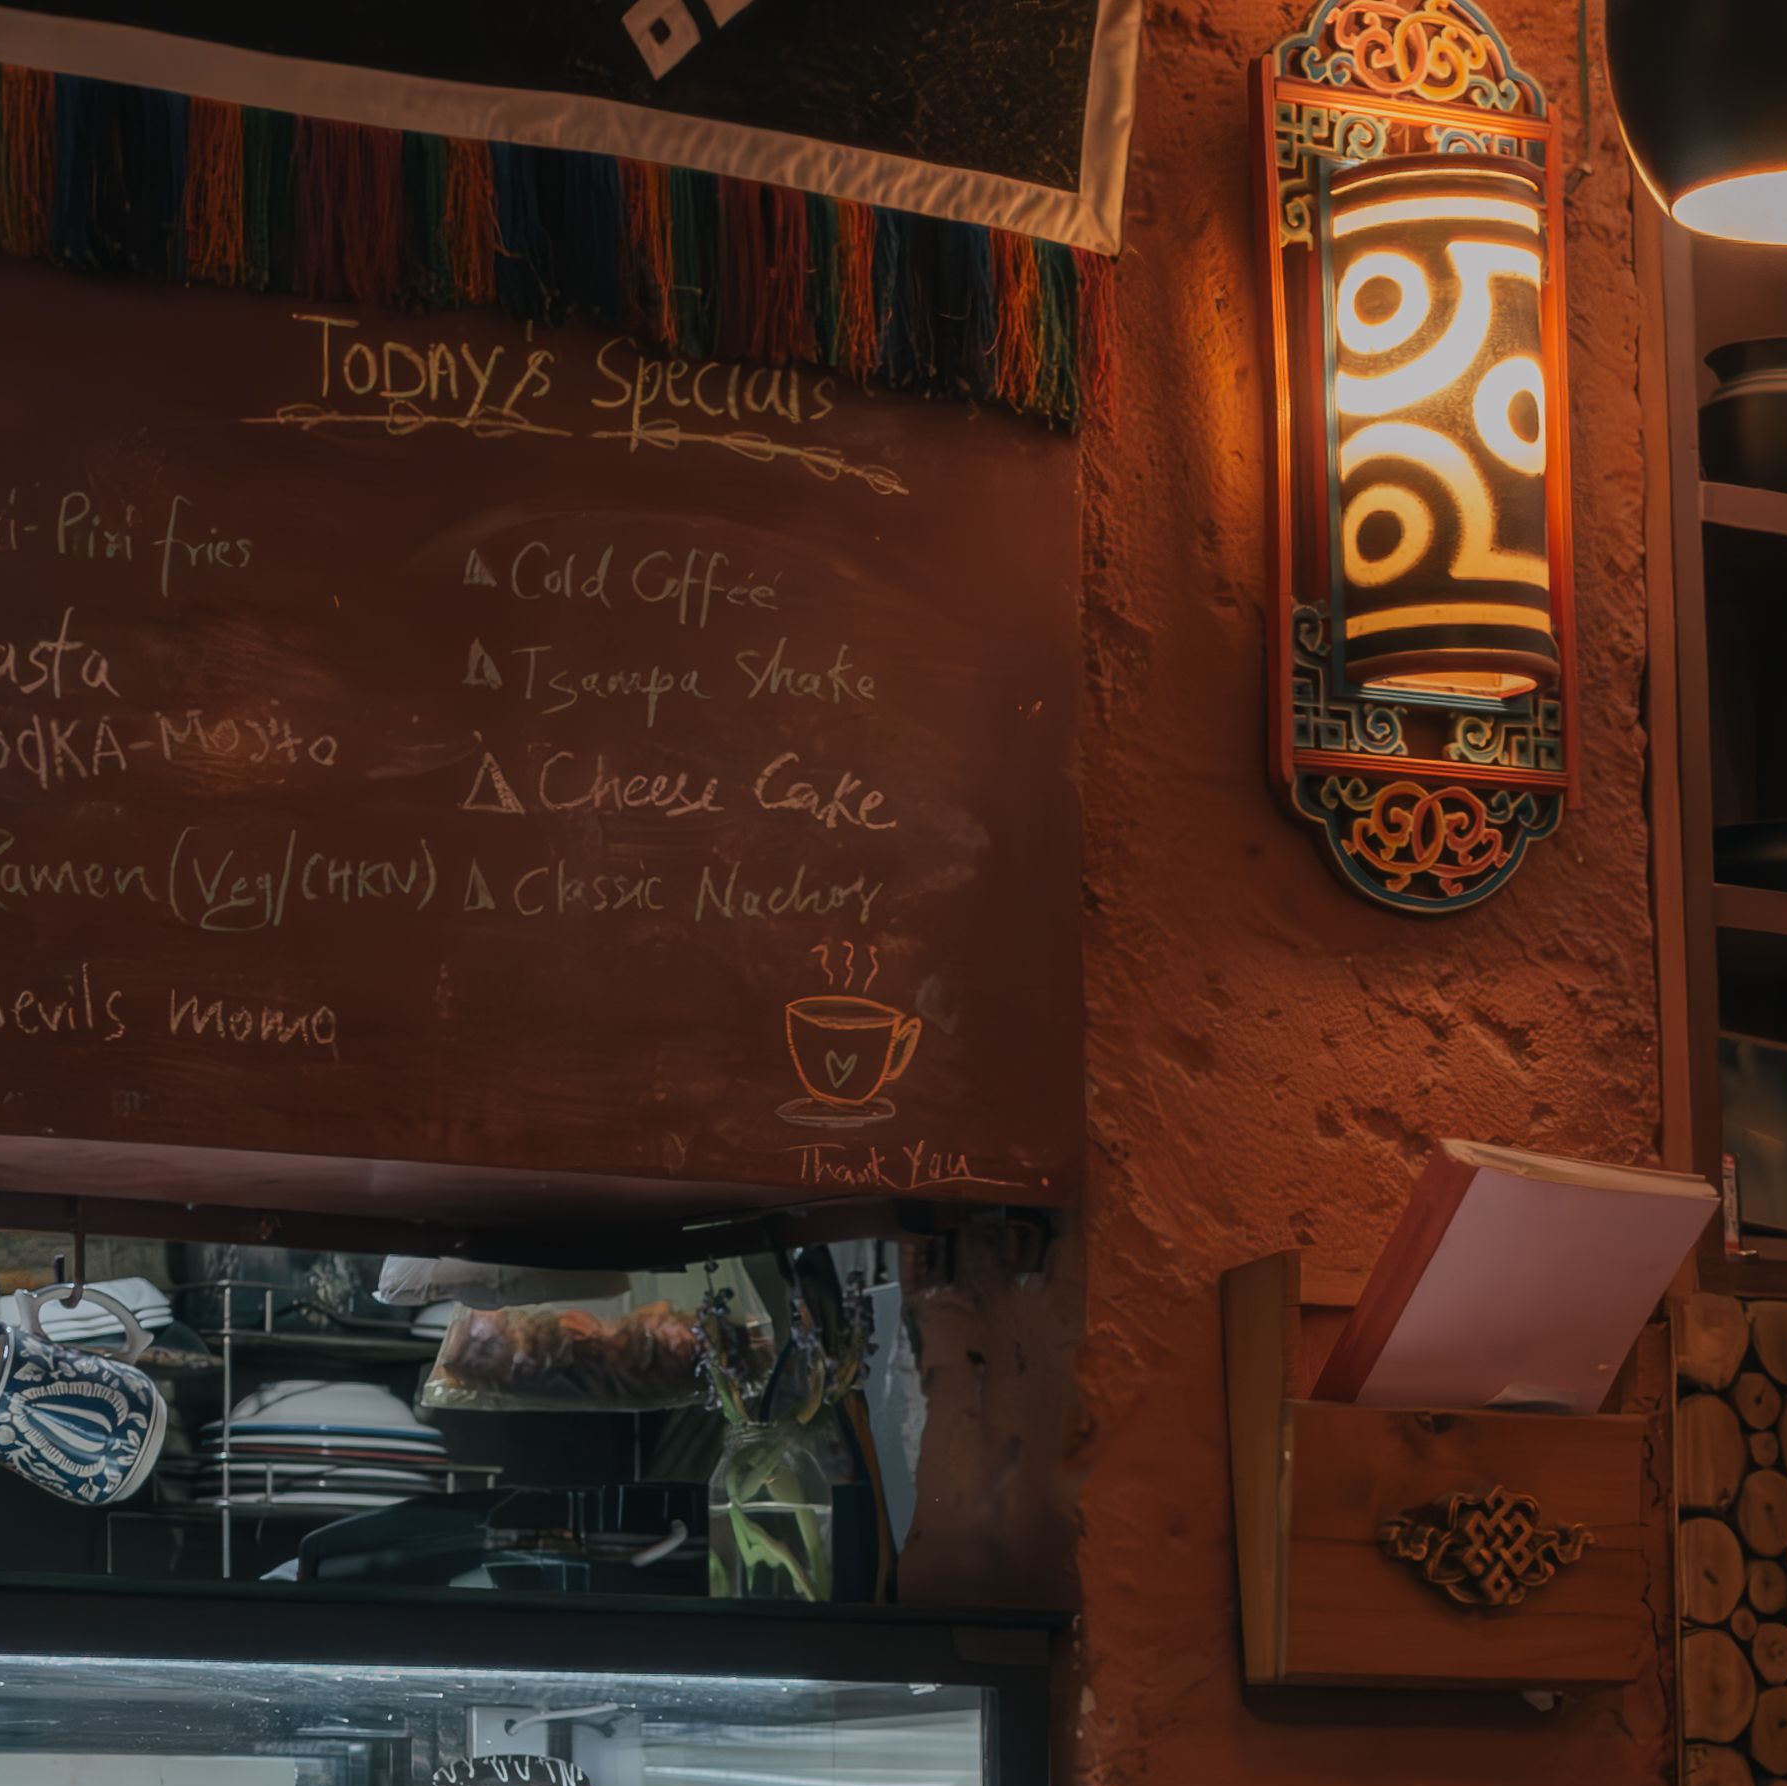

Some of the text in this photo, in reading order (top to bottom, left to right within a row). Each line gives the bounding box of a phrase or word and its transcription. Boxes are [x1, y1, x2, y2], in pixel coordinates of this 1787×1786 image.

[511, 541, 614, 610] Cold
[734, 637, 876, 704] Shake
[539, 751, 897, 830] Cheese Cake
